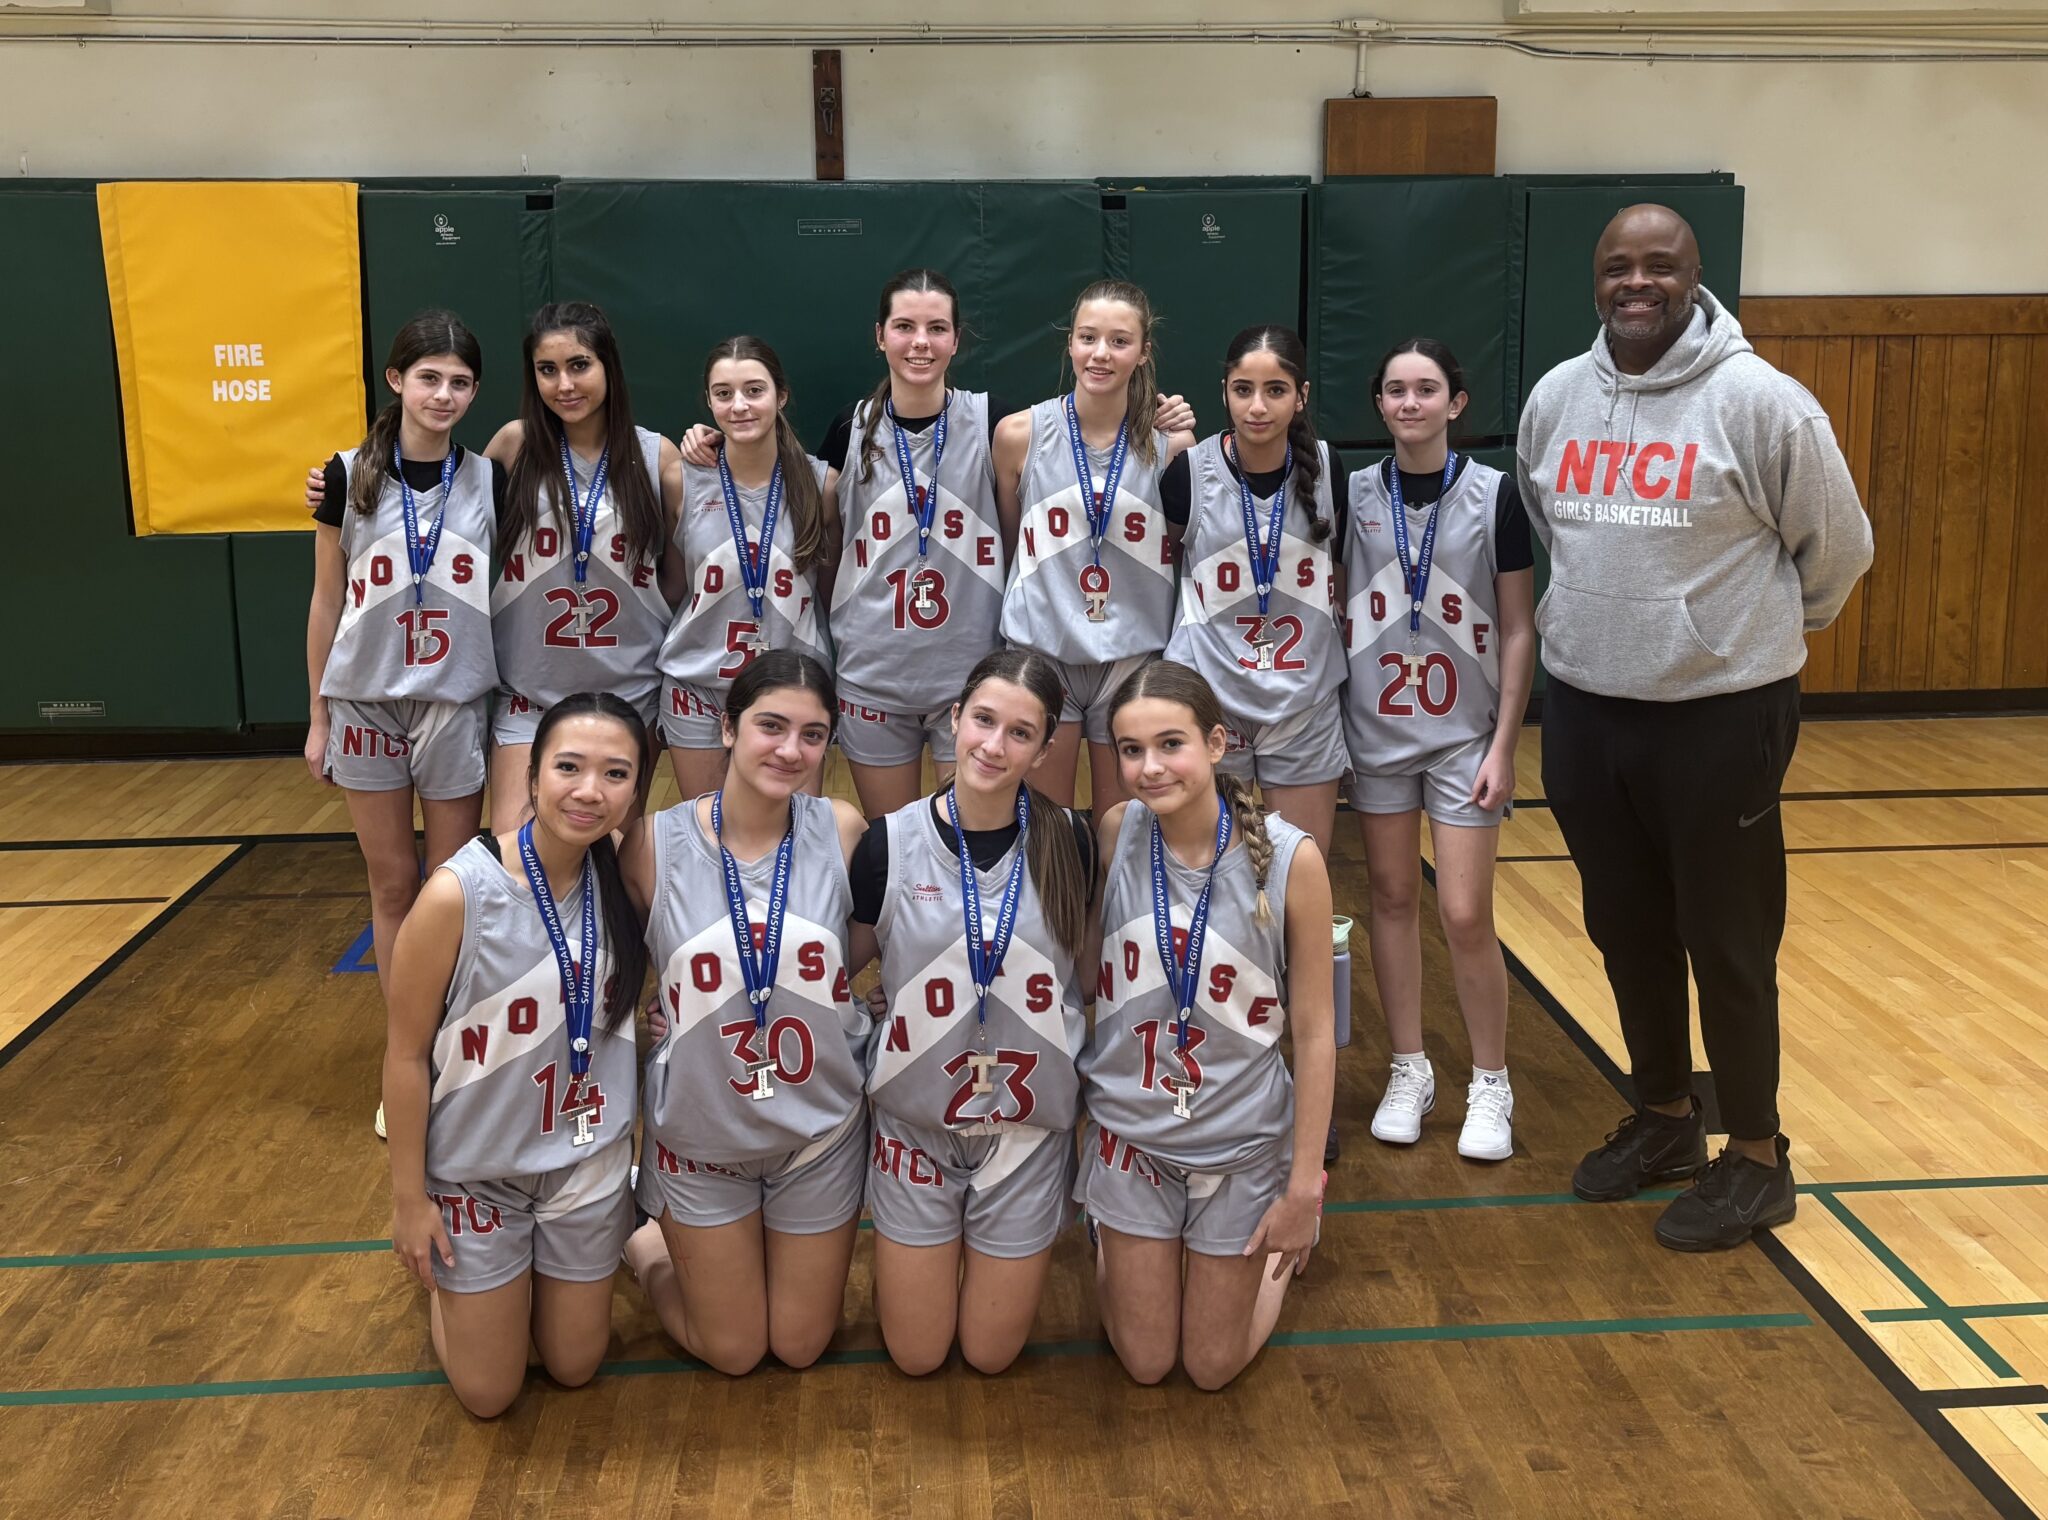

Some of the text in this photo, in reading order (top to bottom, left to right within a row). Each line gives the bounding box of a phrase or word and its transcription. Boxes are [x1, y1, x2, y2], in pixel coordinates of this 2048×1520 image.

[214, 343, 265, 368] FIRE
[212, 379, 272, 402] HOSE
[1555, 439, 1699, 501] NTCI
[1554, 500, 1693, 527] GIRLS BASKETBALL
[543, 586, 620, 648] 22
[884, 568, 950, 630] 18
[395, 609, 452, 667] 15
[717, 620, 760, 679] 5
[1235, 614, 1306, 672] 32
[1377, 651, 1459, 717] 20
[719, 1015, 815, 1097] 30
[941, 1047, 1039, 1126] 23
[1131, 1018, 1207, 1096] 13
[532, 1051, 607, 1135] 14
